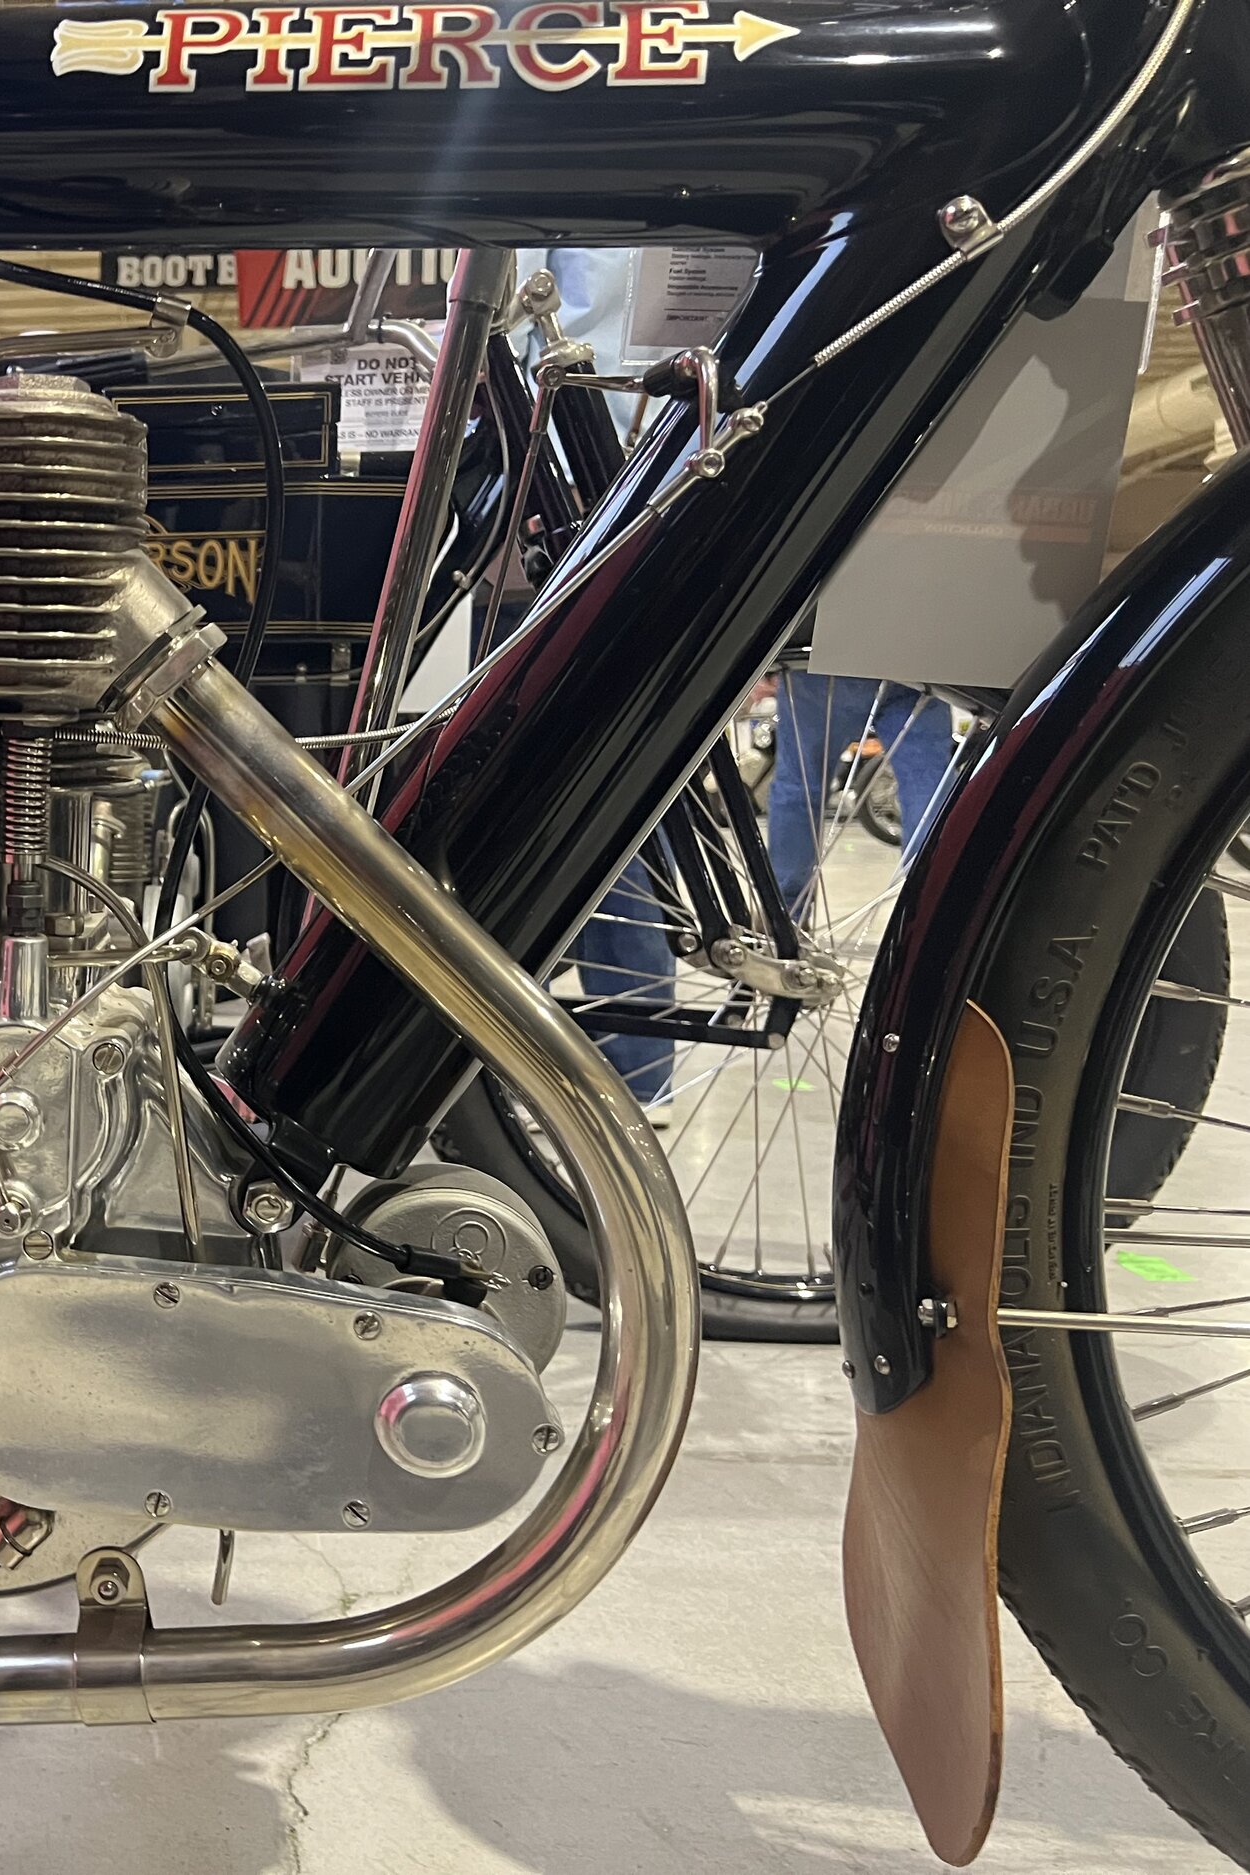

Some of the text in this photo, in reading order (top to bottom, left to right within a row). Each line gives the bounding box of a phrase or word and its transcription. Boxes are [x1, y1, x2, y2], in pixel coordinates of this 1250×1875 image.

[149, 0, 708, 92] PIERCE
[357, 359, 381, 370] DO
[324, 373, 377, 386] START
[380, 428, 420, 438] WARRAN
